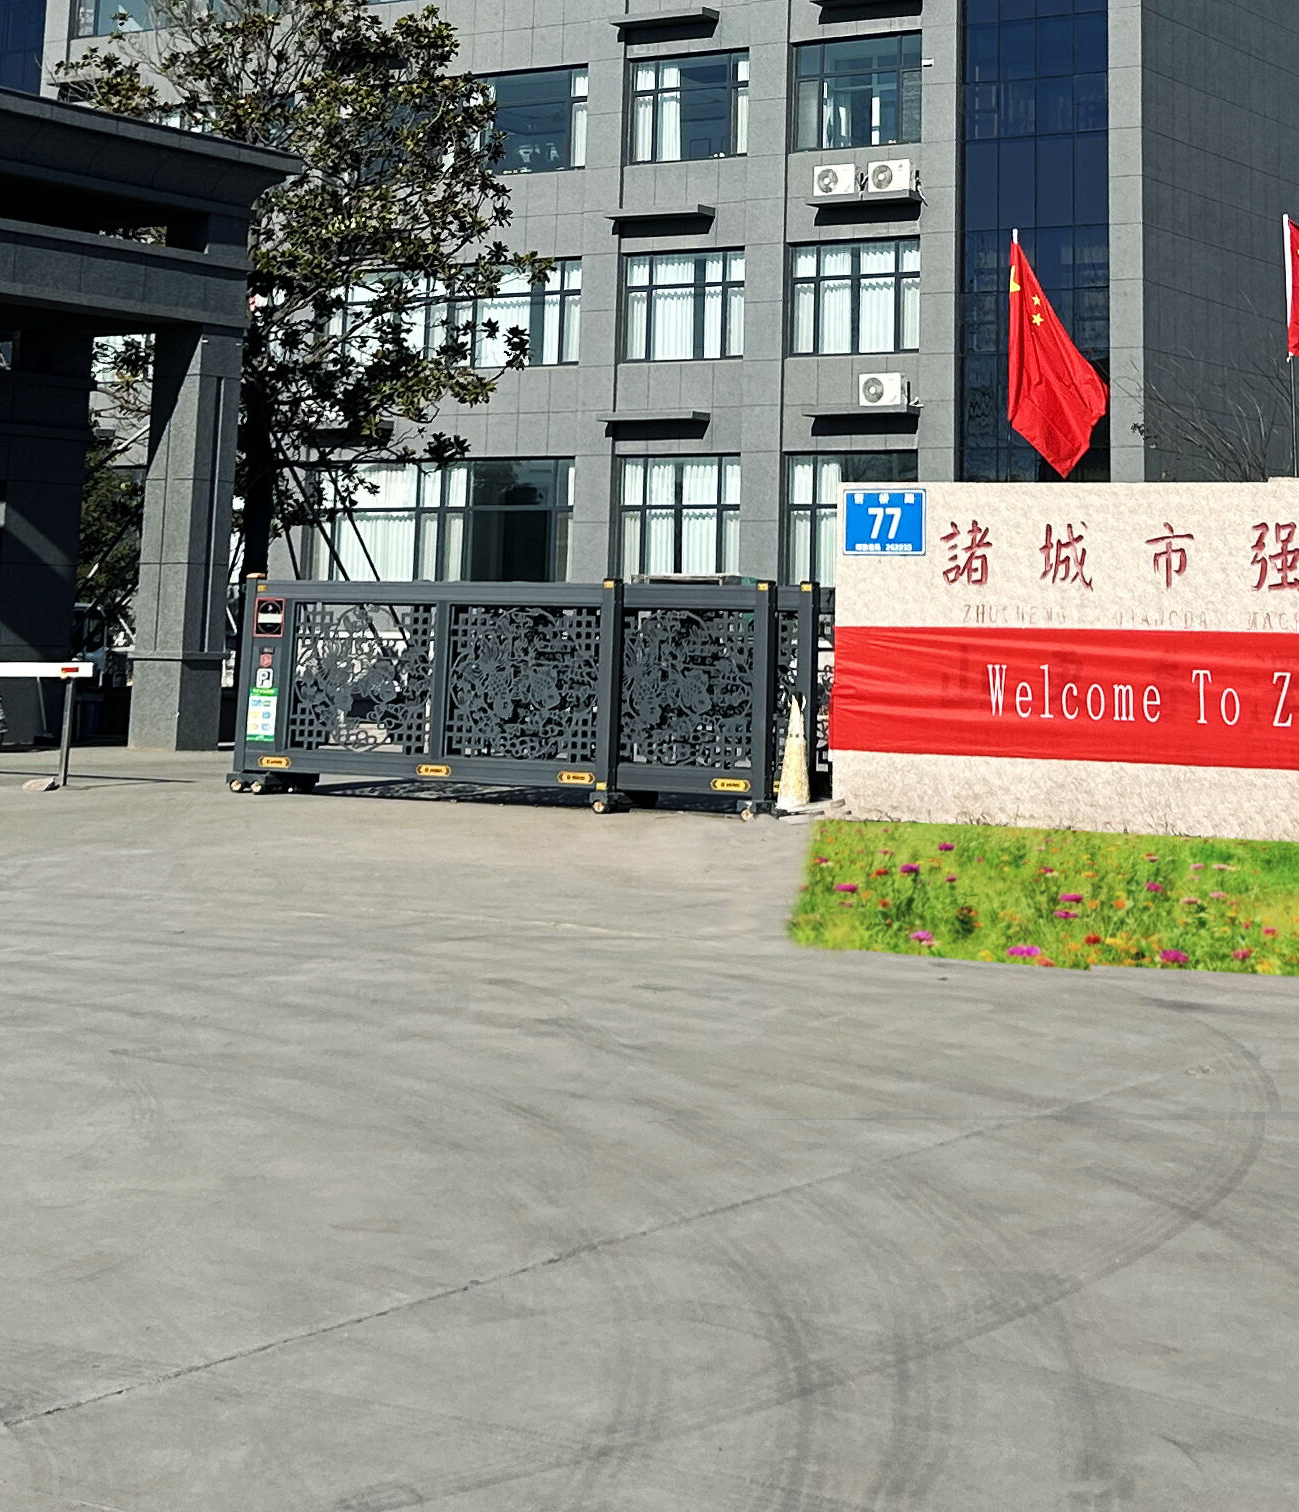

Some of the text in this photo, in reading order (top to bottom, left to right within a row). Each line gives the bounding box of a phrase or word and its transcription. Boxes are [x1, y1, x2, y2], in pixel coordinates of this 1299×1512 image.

[867, 507, 902, 540] 77
[987, 663, 1161, 723] Welcome
[1192, 669, 1241, 727] To
